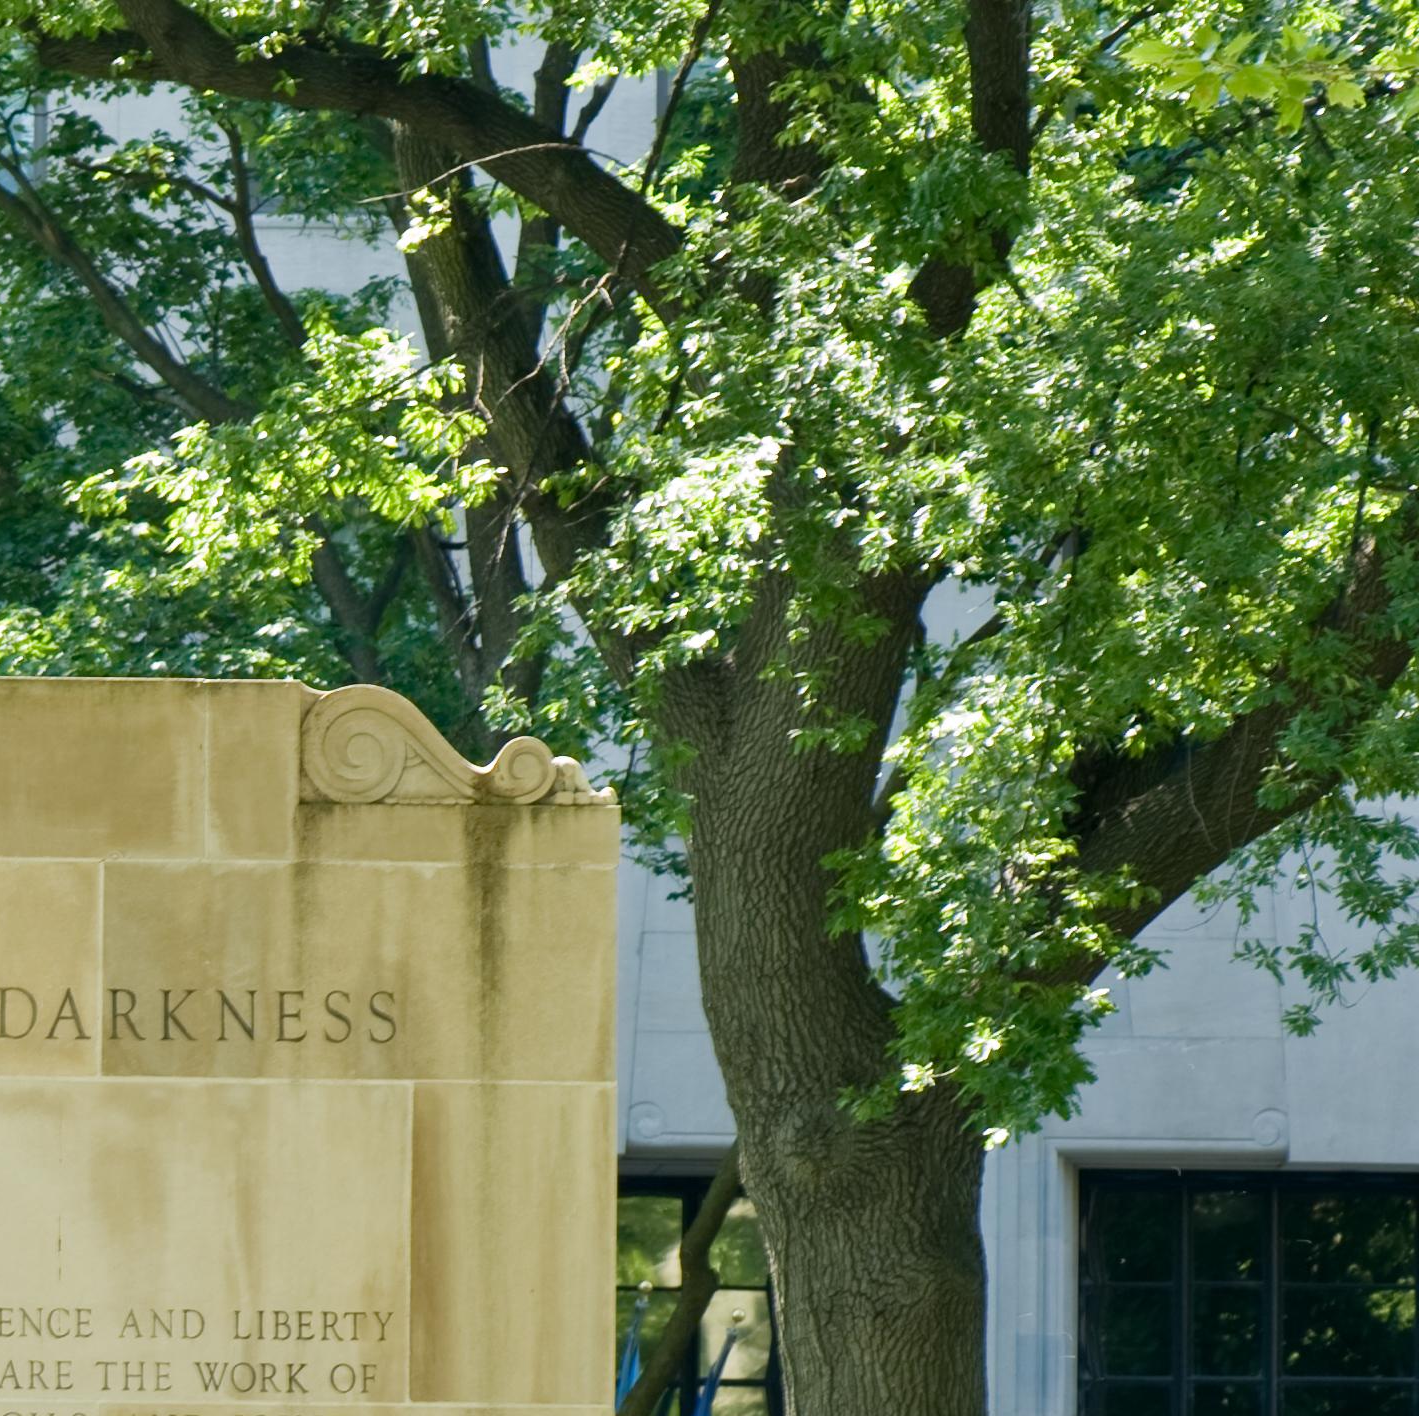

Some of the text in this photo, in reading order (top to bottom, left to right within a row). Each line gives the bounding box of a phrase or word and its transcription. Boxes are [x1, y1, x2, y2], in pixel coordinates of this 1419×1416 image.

[119, 1309, 205, 1340] AND
[233, 1310, 393, 1342] LIBERTY
[95, 1361, 172, 1392] THE
[194, 1362, 309, 1394] WORK
[329, 1363, 377, 1394] OF
